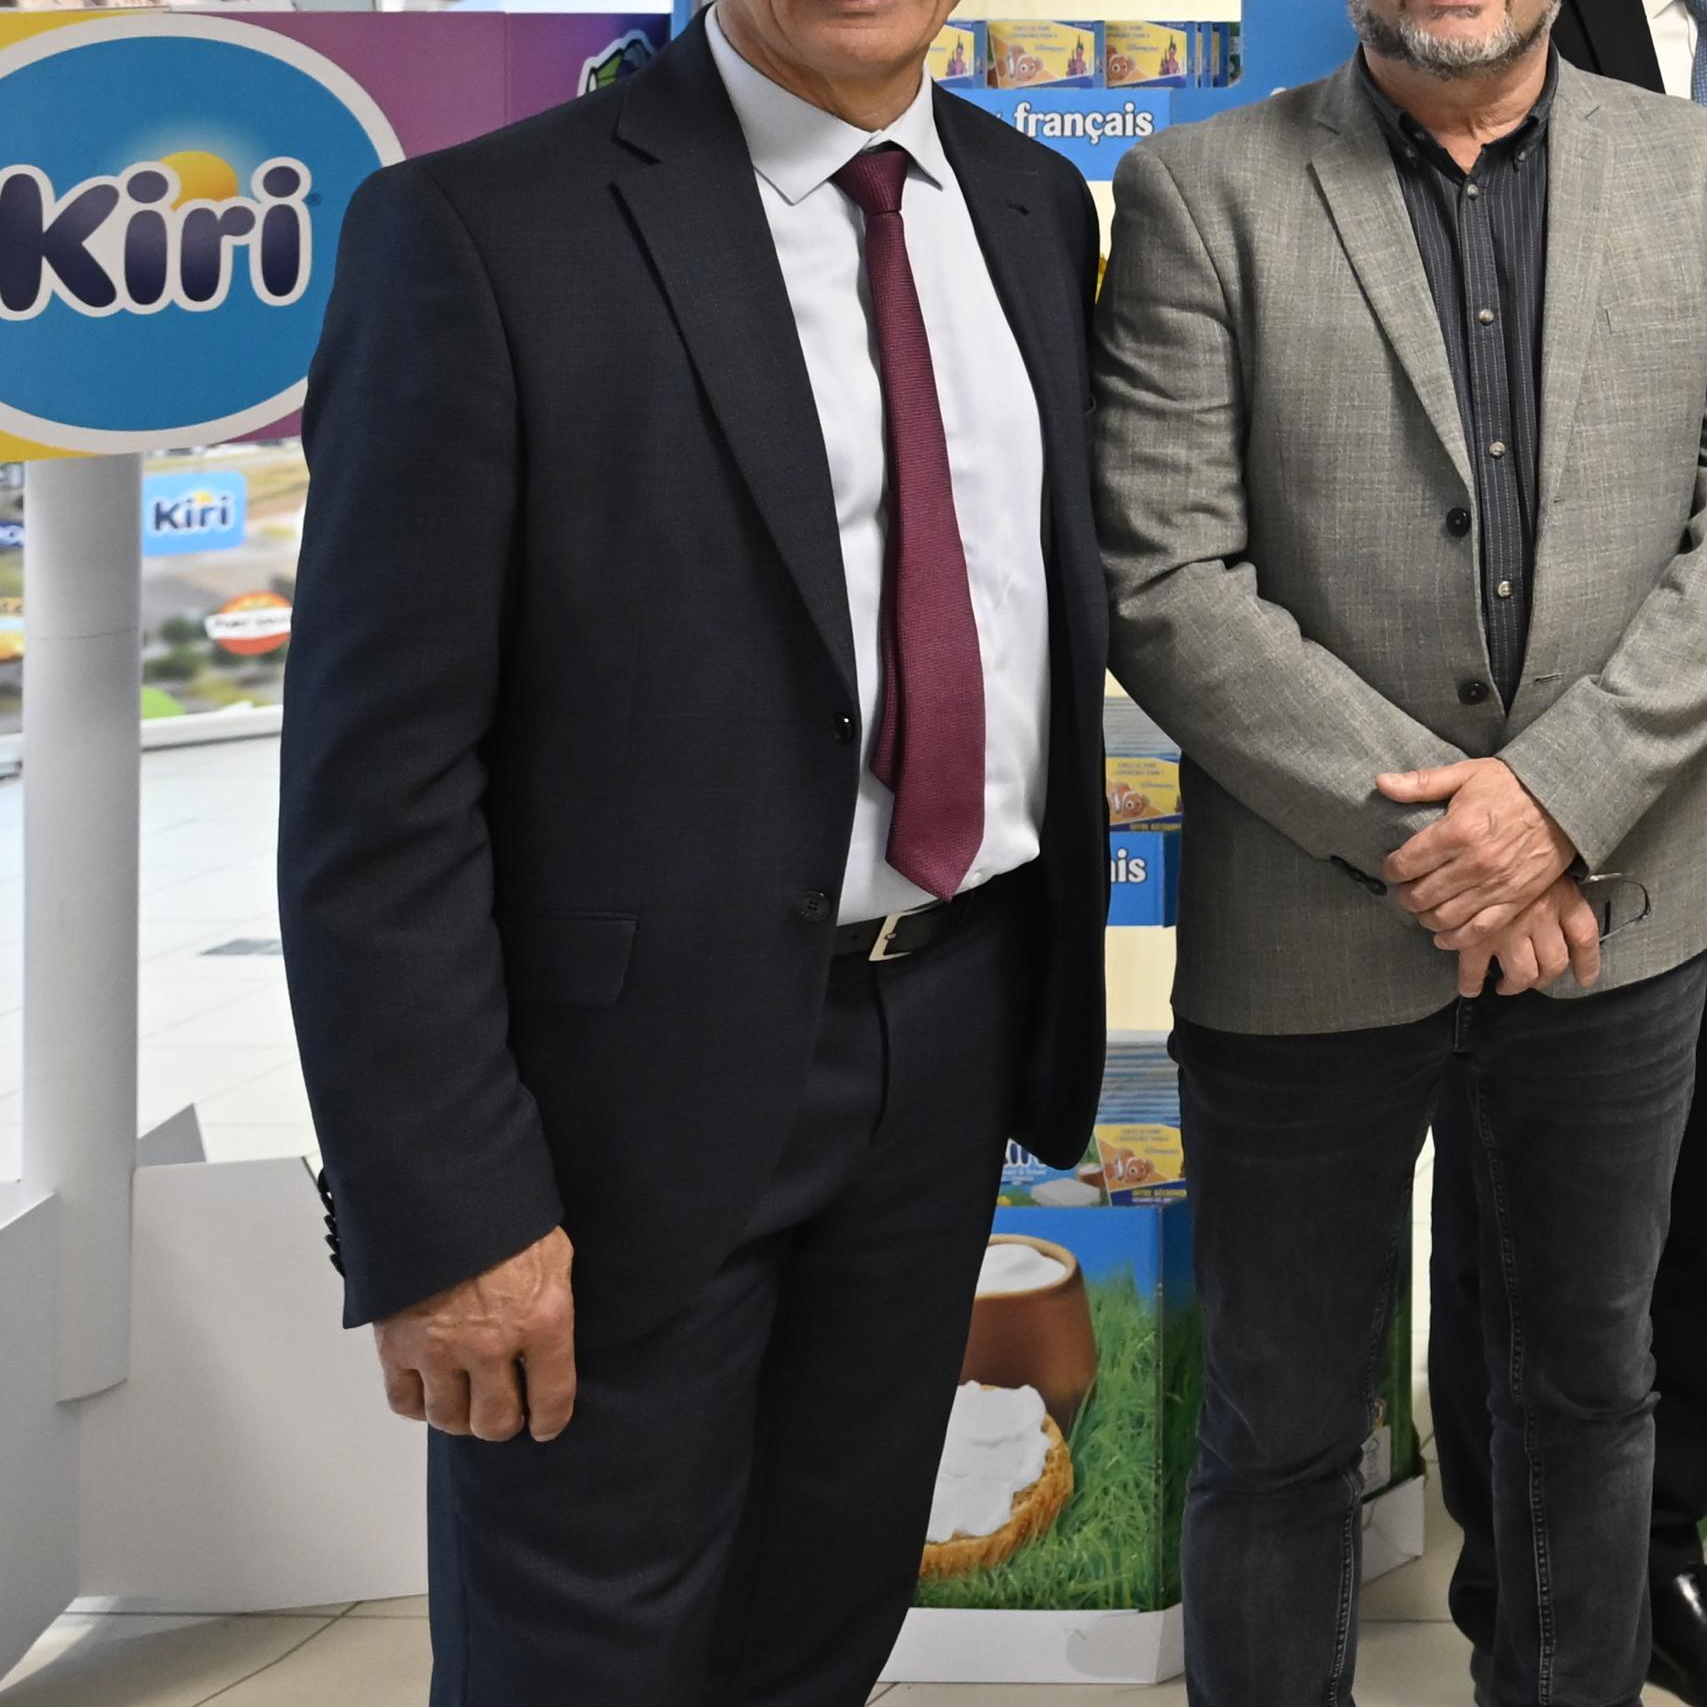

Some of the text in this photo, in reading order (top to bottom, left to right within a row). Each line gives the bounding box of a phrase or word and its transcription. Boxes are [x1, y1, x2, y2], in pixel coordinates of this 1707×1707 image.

[1014, 102, 1153, 144] français
[0, 156, 312, 320] Kiri
[152, 494, 231, 533] Kiri
